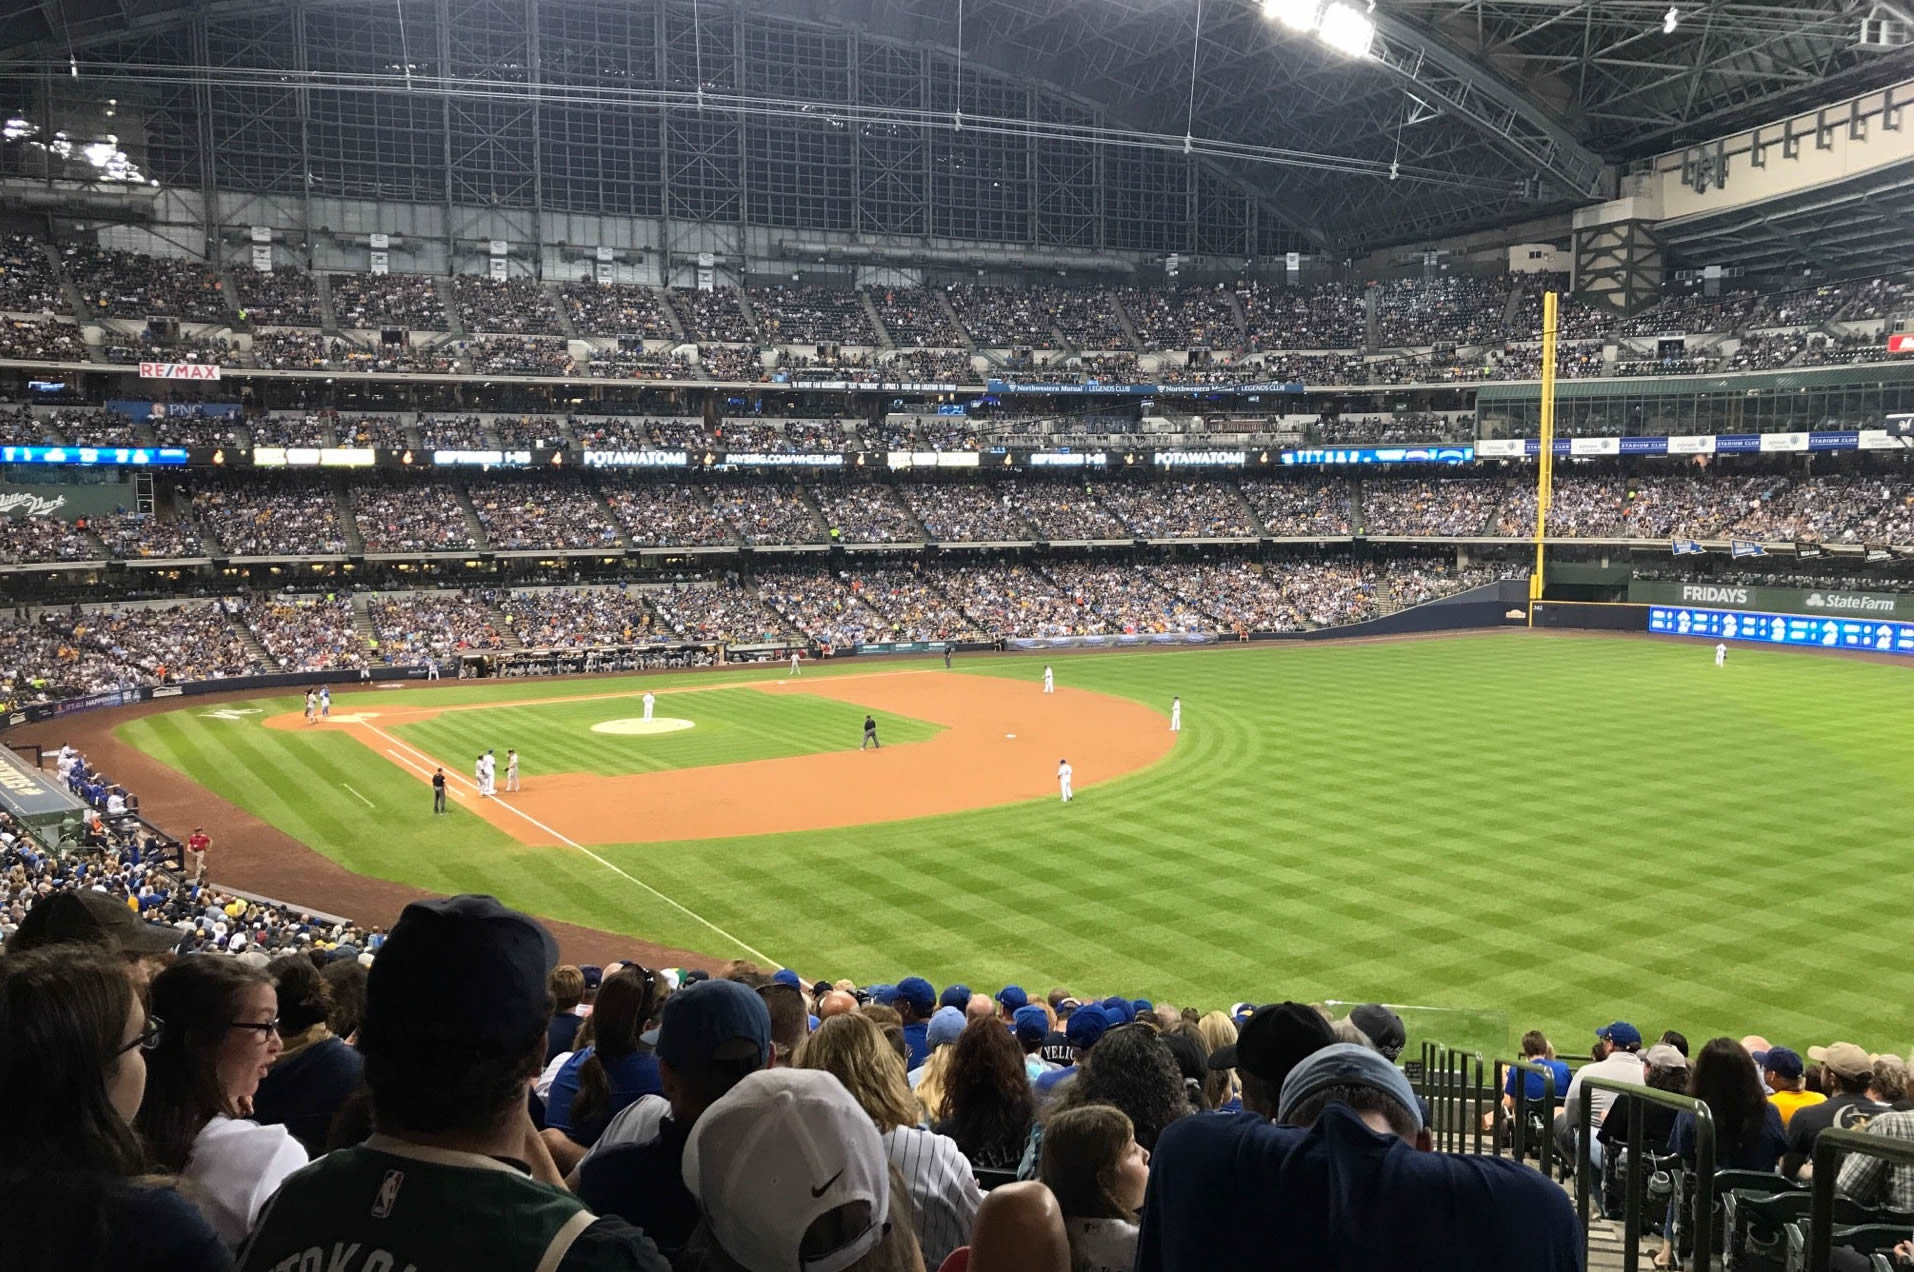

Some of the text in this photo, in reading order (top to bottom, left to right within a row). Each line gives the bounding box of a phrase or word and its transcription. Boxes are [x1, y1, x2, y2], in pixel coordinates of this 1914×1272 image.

[141, 364, 216, 379] RE/MAX
[1017, 384, 1059, 392] Northwestern
[1241, 384, 1269, 392] LEGENDS
[583, 451, 687, 465] POTAWATOMI
[1154, 452, 1246, 464] POTAWATOMI
[0, 492, 66, 516] iller Park
[1683, 585, 1748, 604] FRIDAYS
